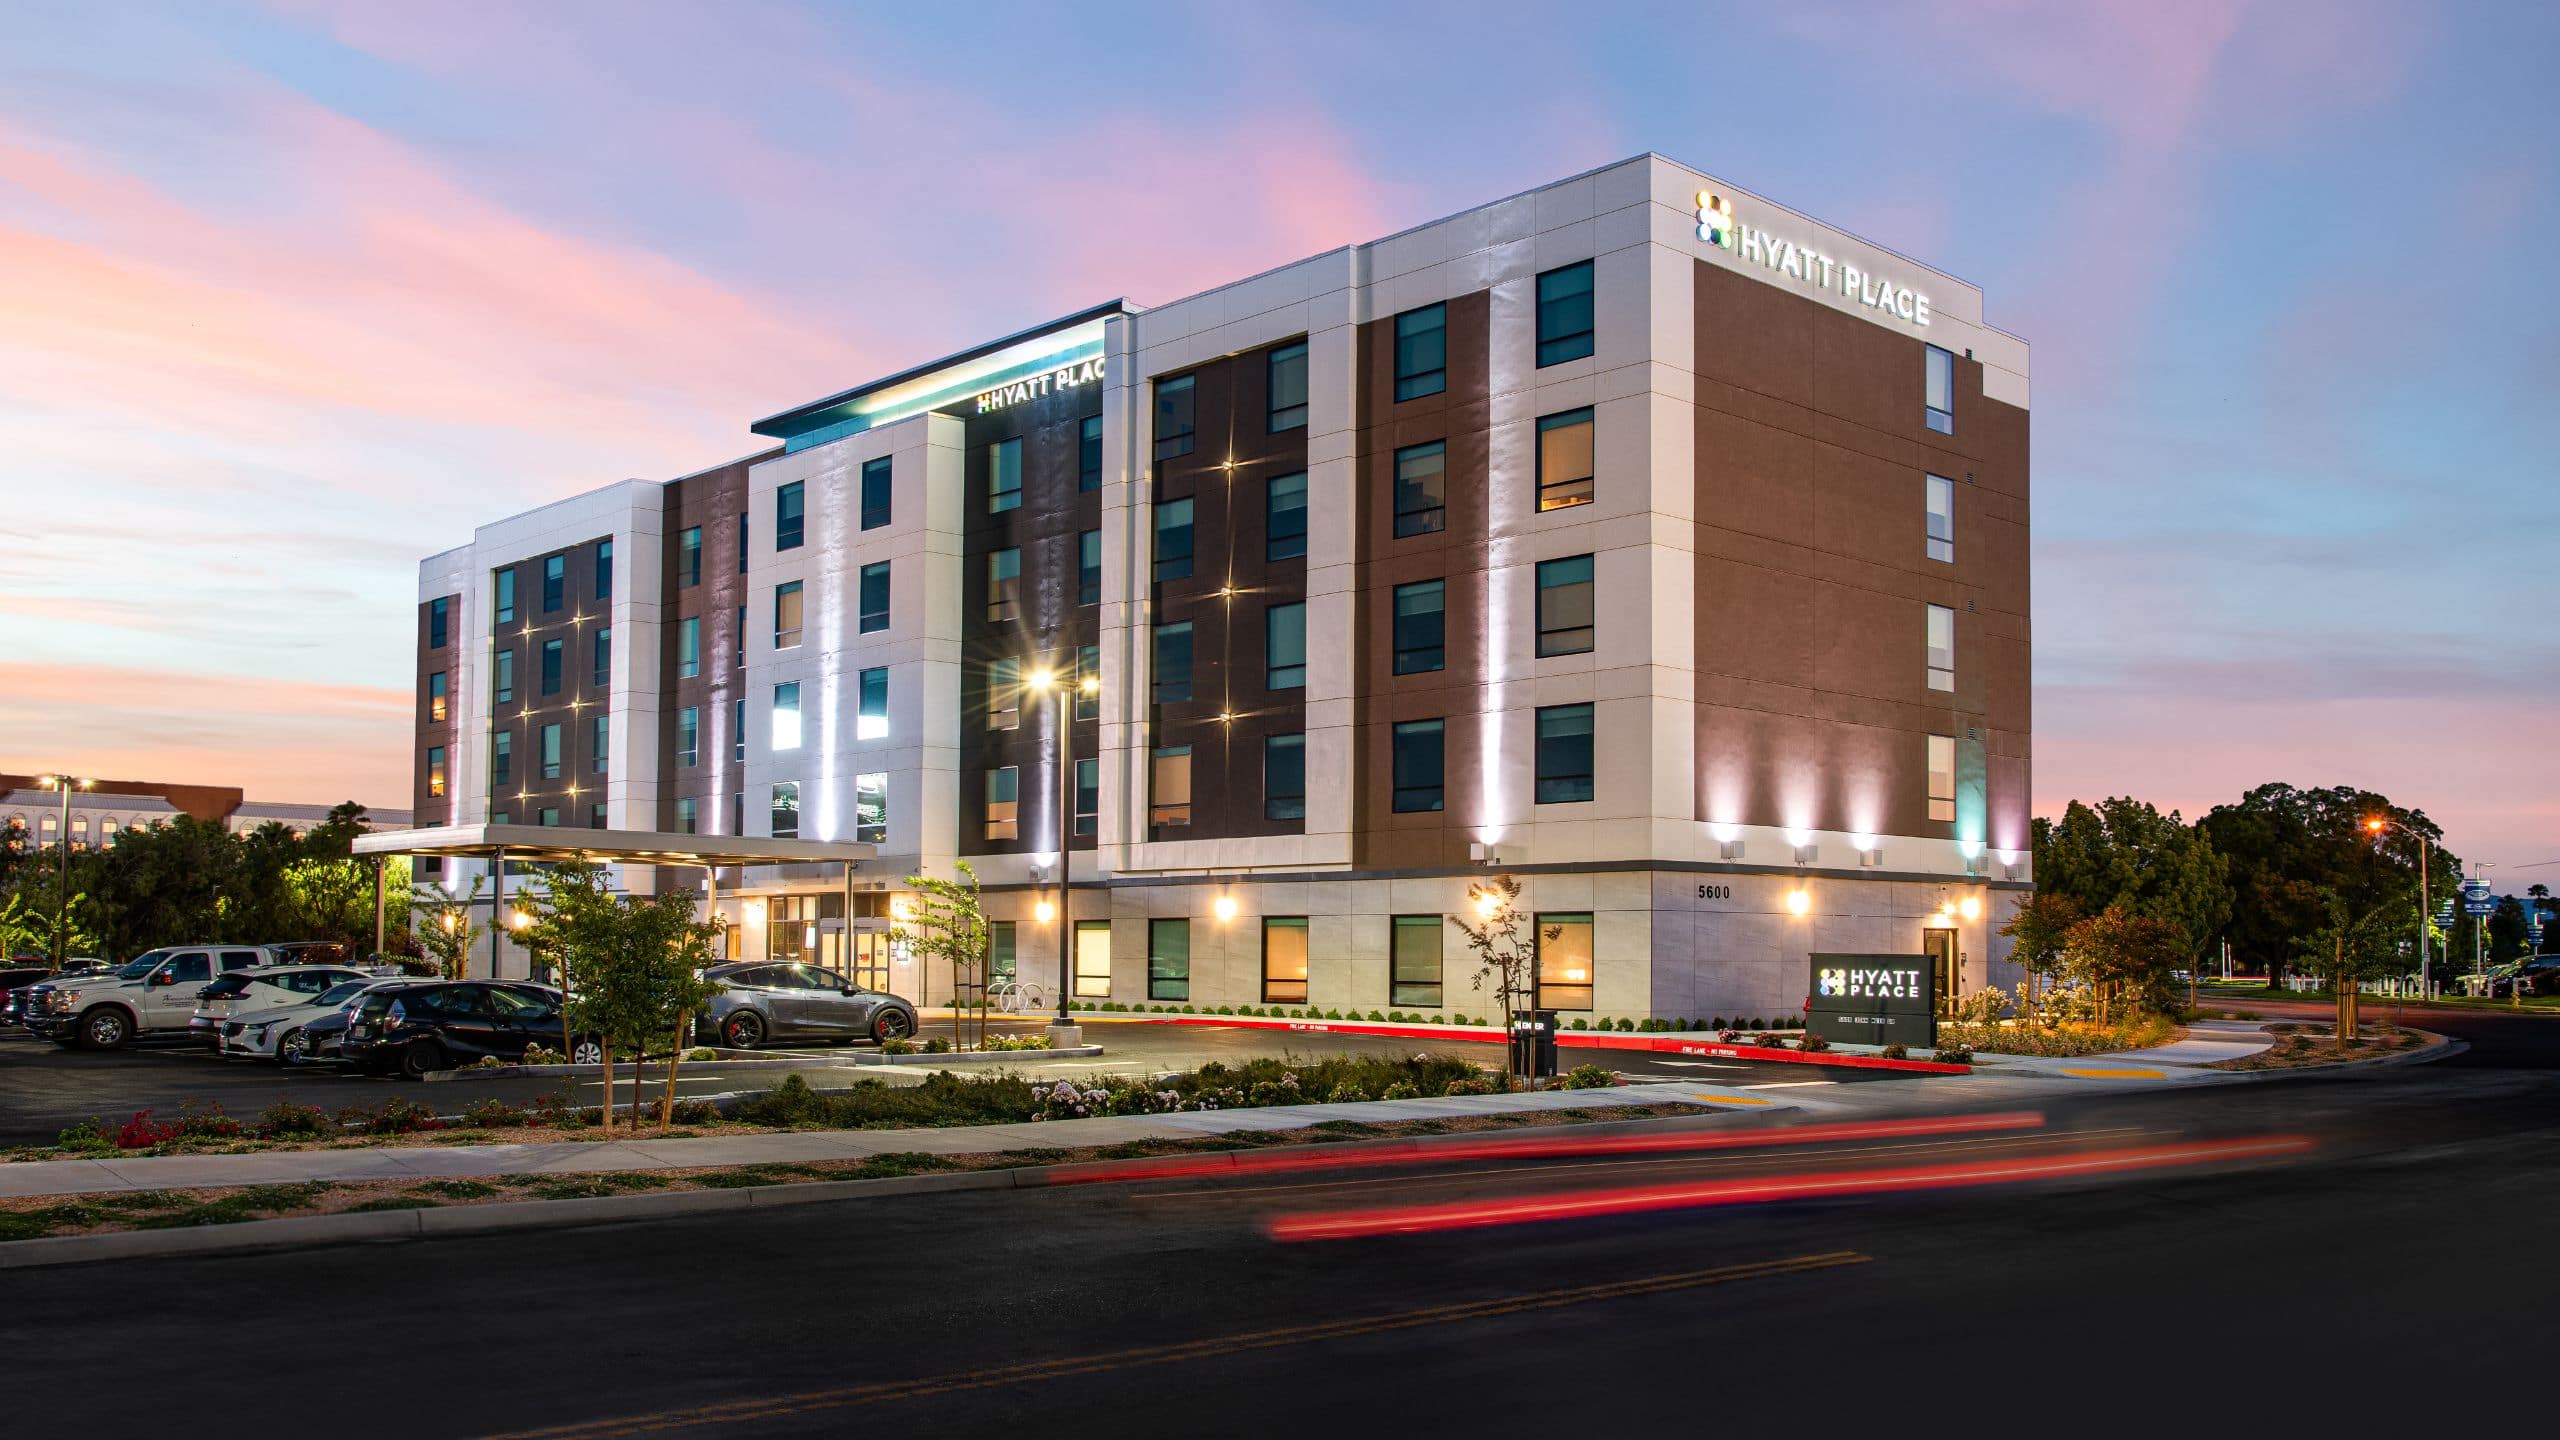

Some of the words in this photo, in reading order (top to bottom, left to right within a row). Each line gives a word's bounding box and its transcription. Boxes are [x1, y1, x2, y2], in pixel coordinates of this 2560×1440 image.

[1738, 225, 1833, 288] HYATT
[1842, 264, 1930, 326] PLACE
[991, 375, 1051, 410] HYATT
[1699, 885, 1729, 899] 5600
[1850, 969, 1920, 985] HYATT
[1850, 985, 1919, 998] PLACE
[1522, 1021, 1545, 1031] ENER
[1683, 1046, 1693, 1055] FIRE
[1694, 1047, 1706, 1056] LANE
